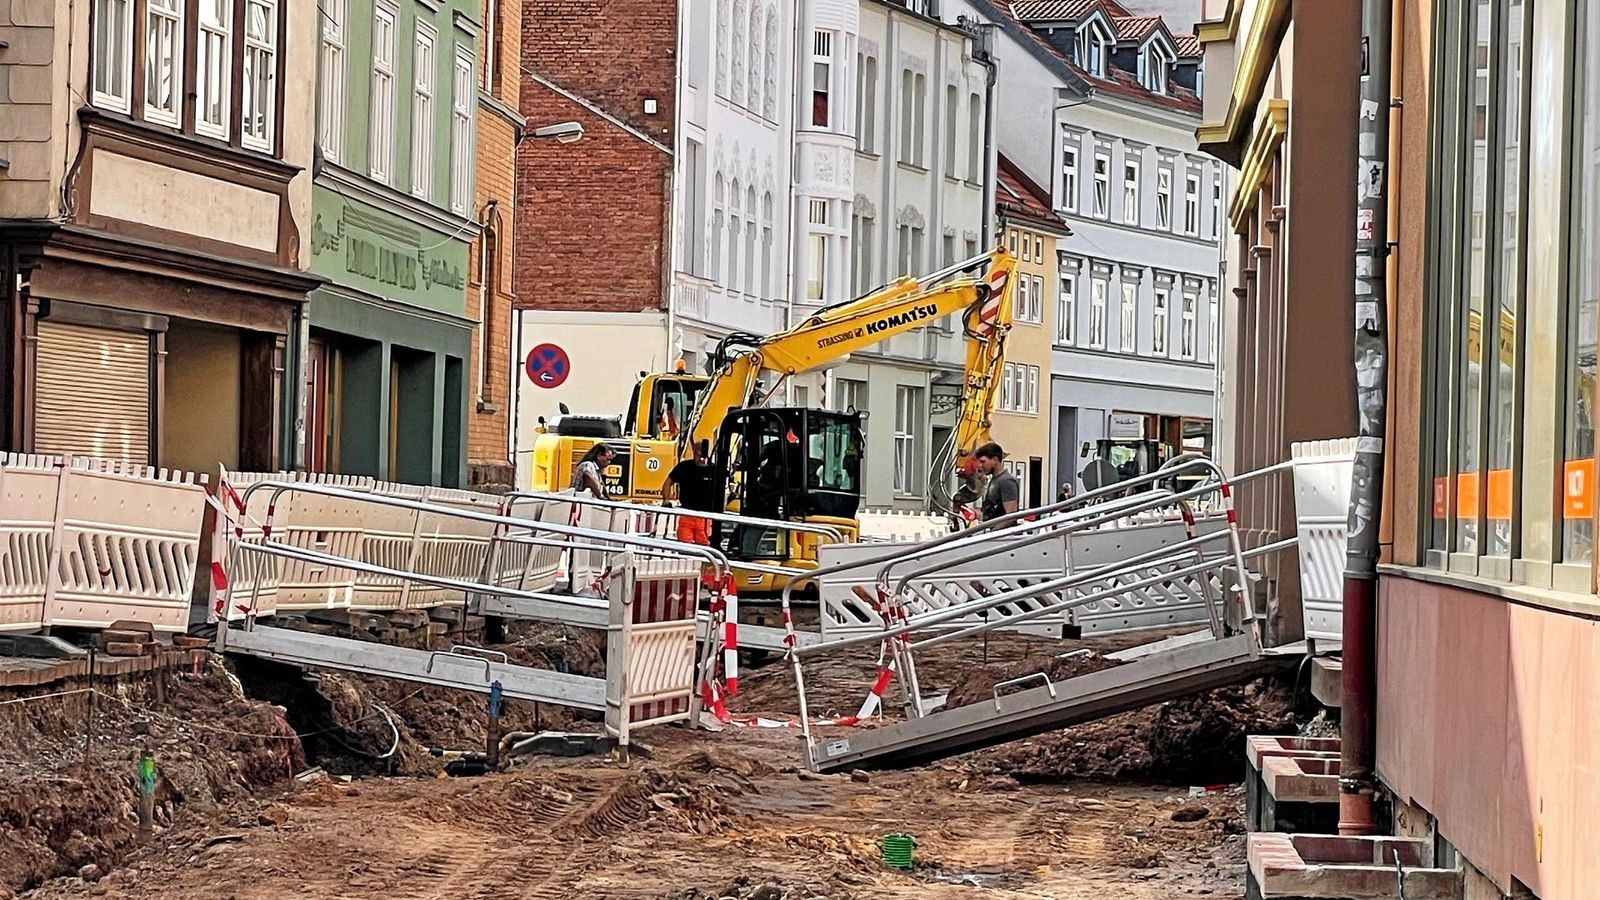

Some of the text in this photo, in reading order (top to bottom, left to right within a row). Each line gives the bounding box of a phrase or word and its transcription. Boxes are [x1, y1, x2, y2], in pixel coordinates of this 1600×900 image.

[817, 304, 938, 349] STRASSING KOMATSU
[648, 460, 658, 470] 20
